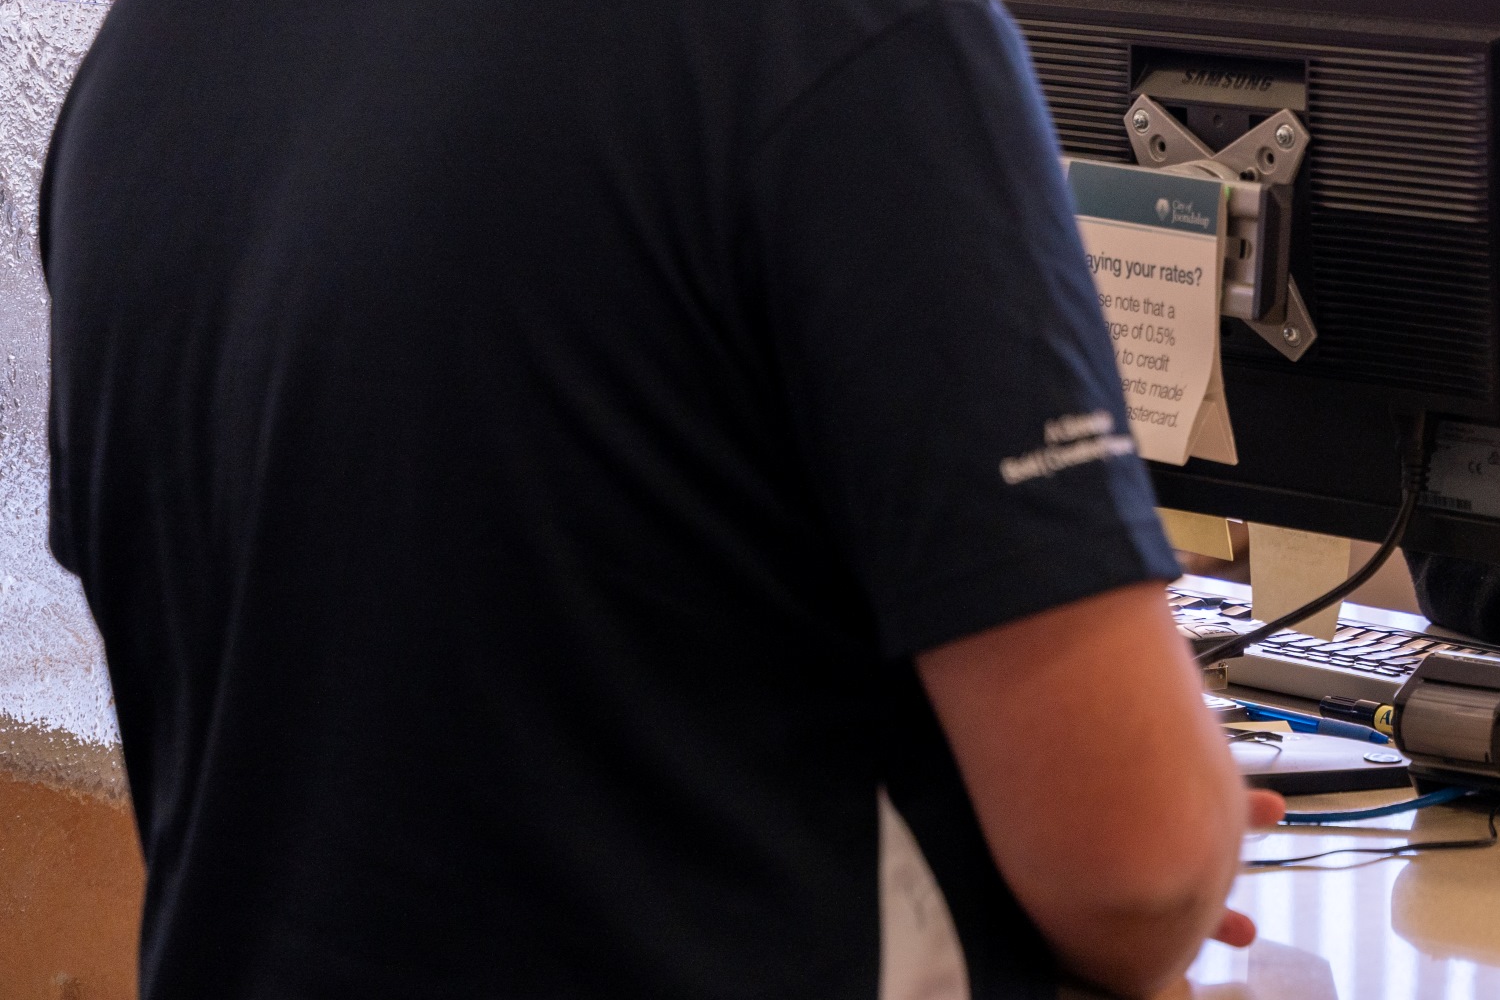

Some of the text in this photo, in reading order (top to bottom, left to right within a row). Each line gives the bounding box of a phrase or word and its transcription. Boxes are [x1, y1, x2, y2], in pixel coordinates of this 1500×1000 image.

[1182, 69, 1273, 92] SAMSUNG
[1085, 251, 1203, 287] aying your rates?
[1115, 295, 1141, 313] note
[1142, 298, 1166, 318] that
[1167, 305, 1176, 319] a
[1131, 323, 1144, 340] of
[1145, 325, 1176, 347] 0.5%
[1122, 348, 1134, 366] to
[1136, 354, 1170, 373] credit
[1149, 383, 1184, 402] made
[1127, 406, 1178, 428] astercard.
